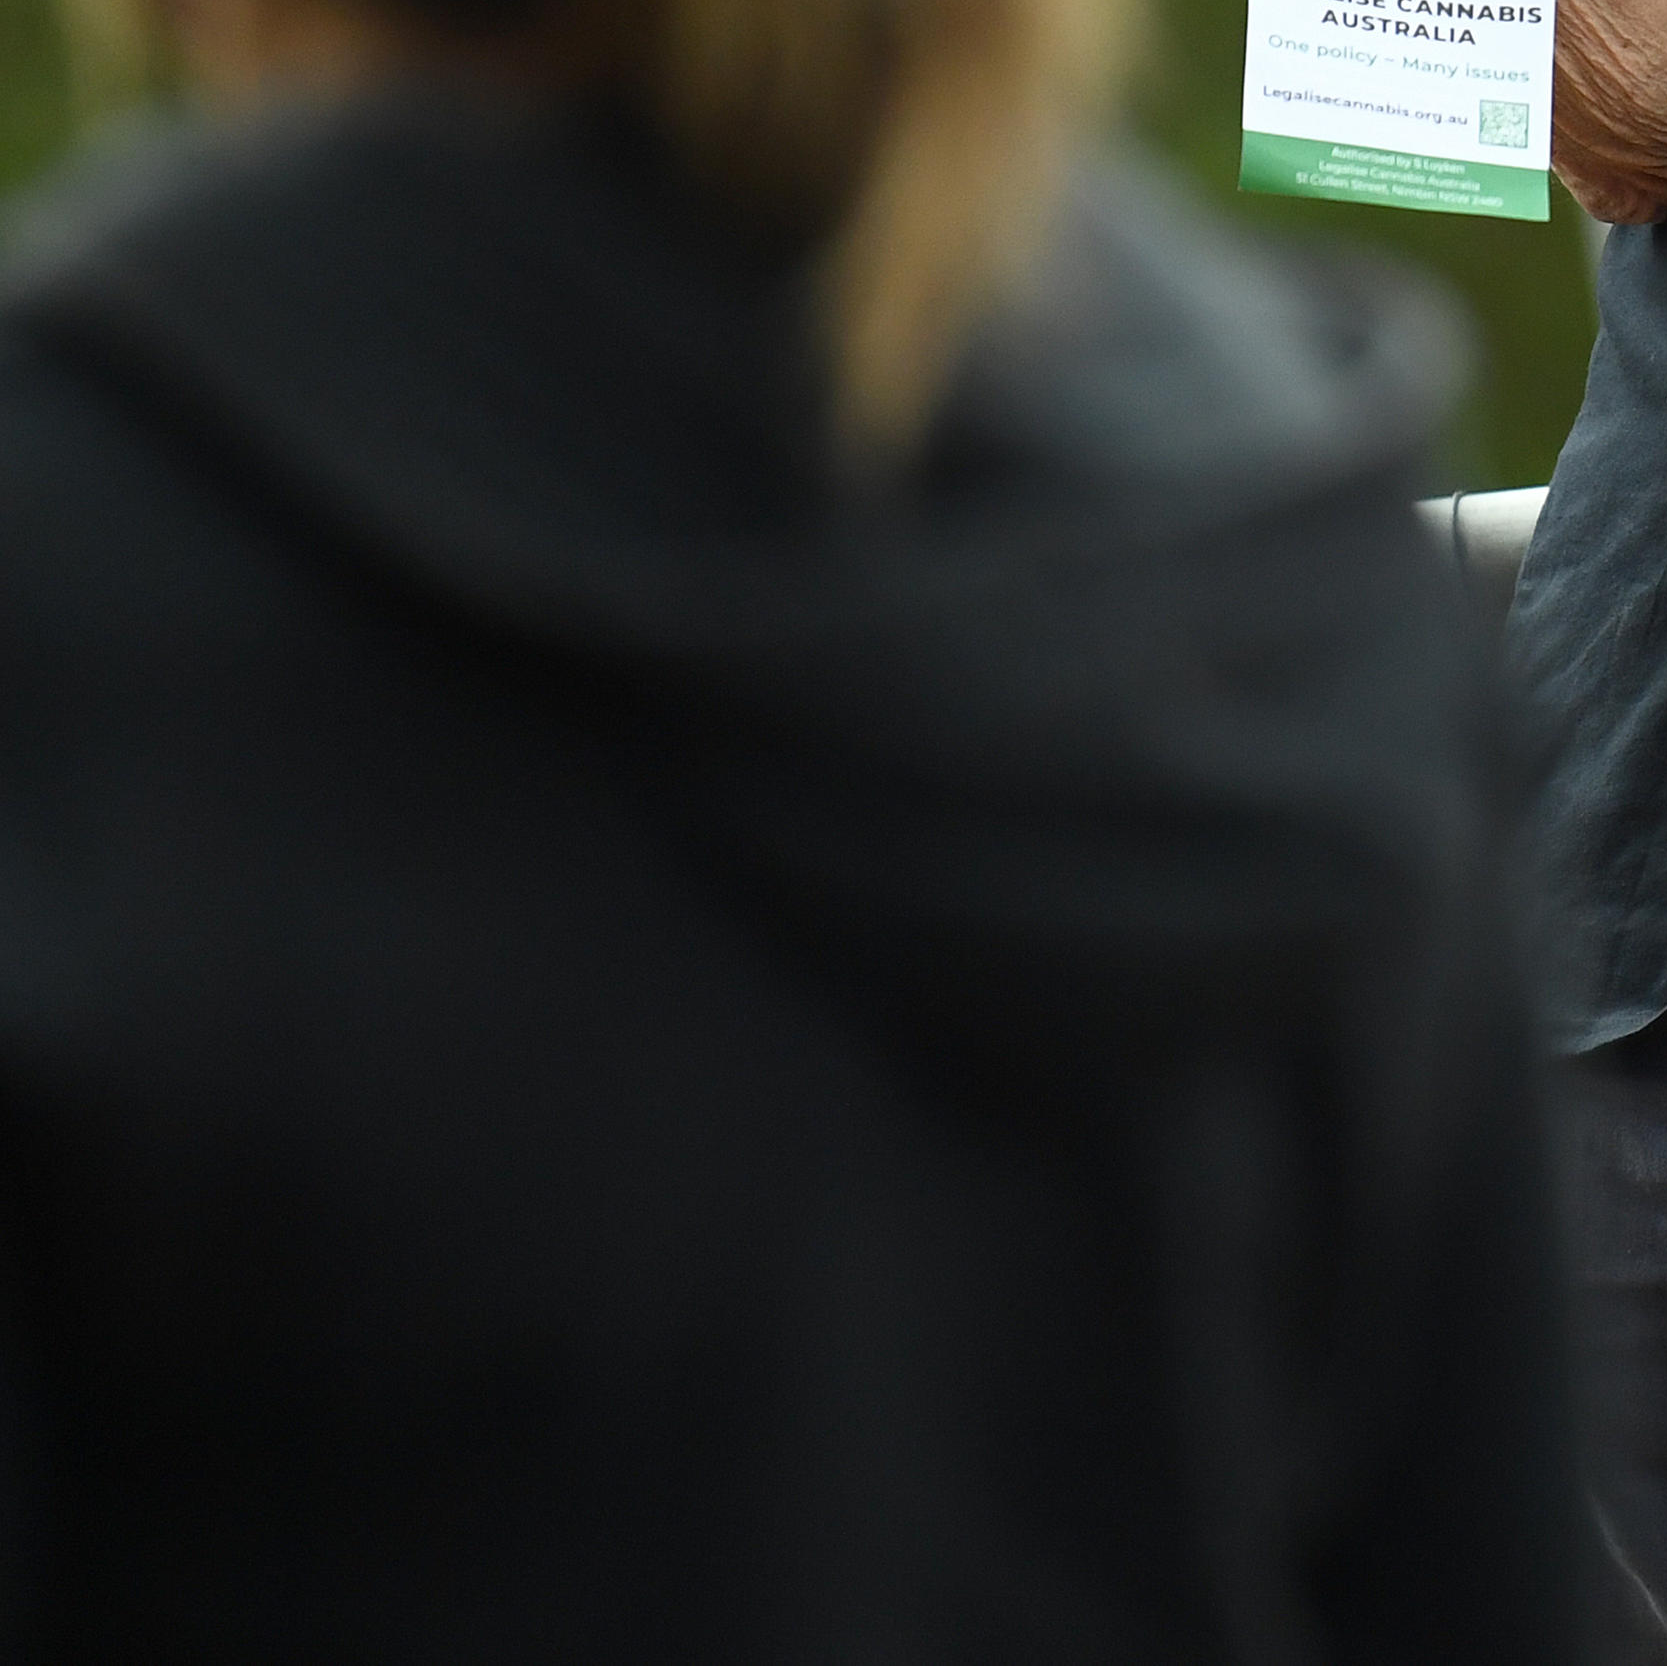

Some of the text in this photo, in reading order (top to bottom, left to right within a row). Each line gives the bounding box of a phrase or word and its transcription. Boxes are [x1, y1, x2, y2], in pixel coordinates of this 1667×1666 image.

[1321, 10, 1476, 45] AUSTRALIA
[1268, 35, 1310, 52] One
[1317, 45, 1378, 66] policy
[1403, 57, 1458, 78] Many
[1466, 63, 1530, 82] issues
